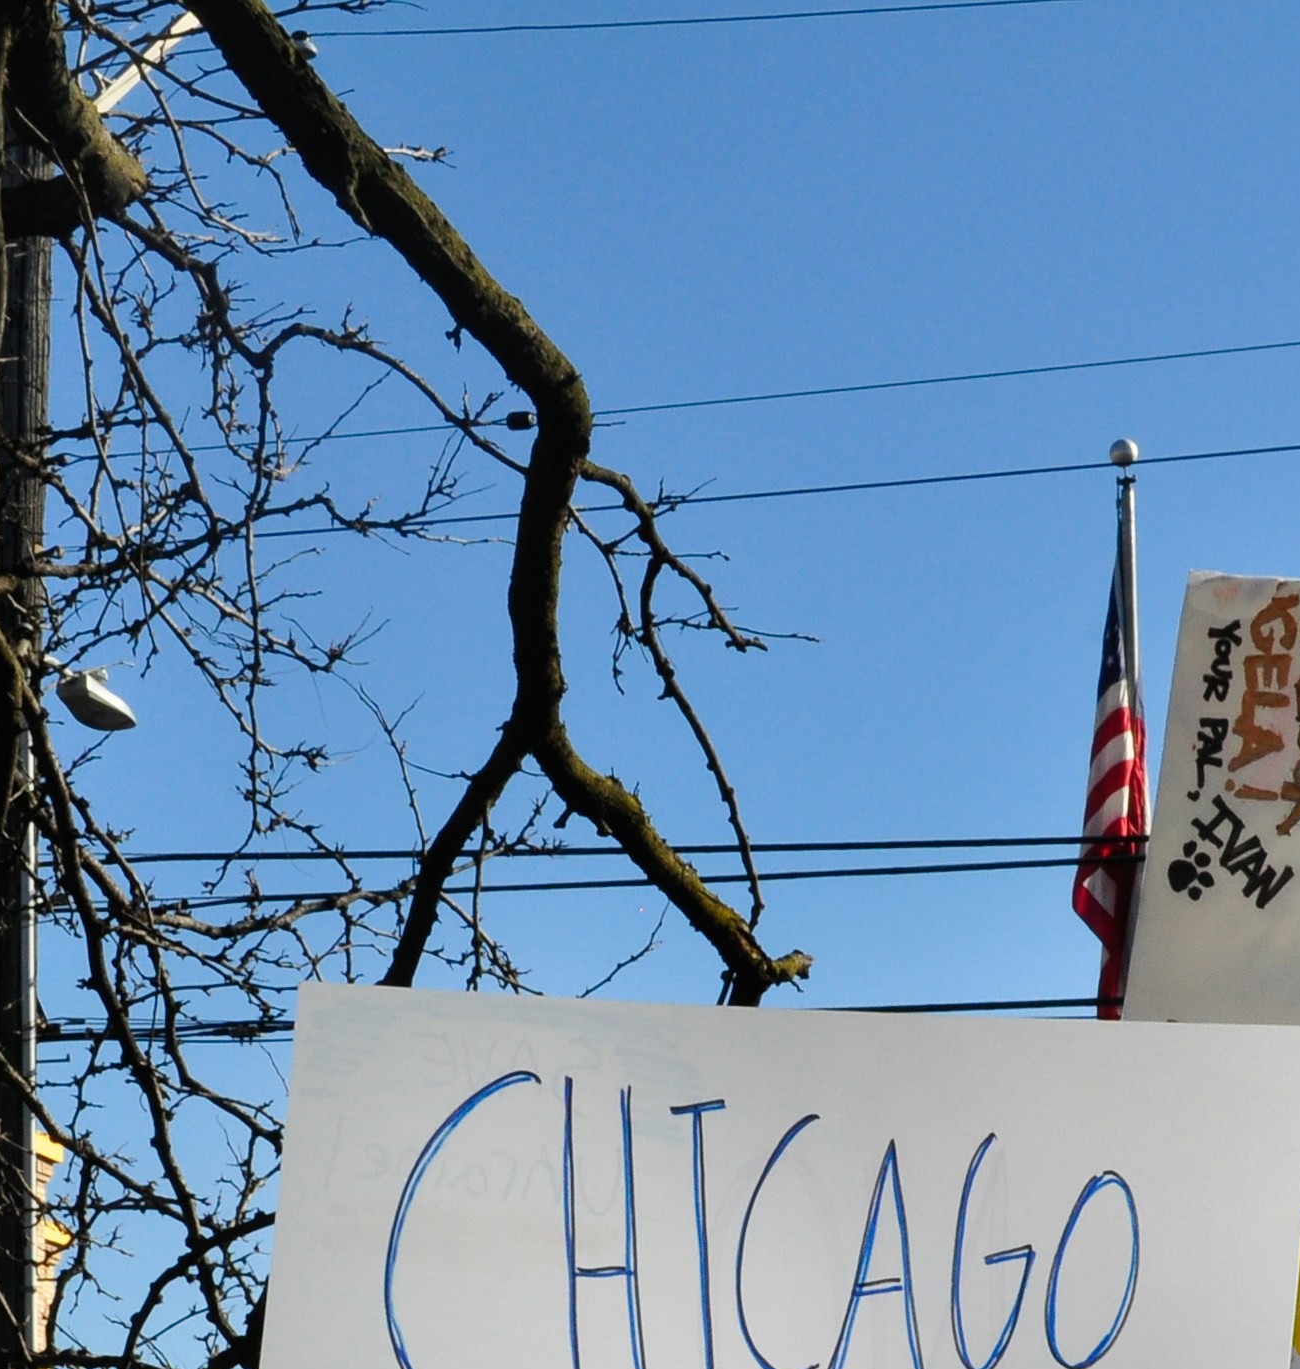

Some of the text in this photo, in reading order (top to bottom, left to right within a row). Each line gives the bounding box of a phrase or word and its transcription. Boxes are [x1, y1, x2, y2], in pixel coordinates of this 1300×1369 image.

[1203, 619, 1242, 702] YOUR
[1225, 582, 1300, 801] GELA!
[1191, 794, 1295, 910] IVAN
